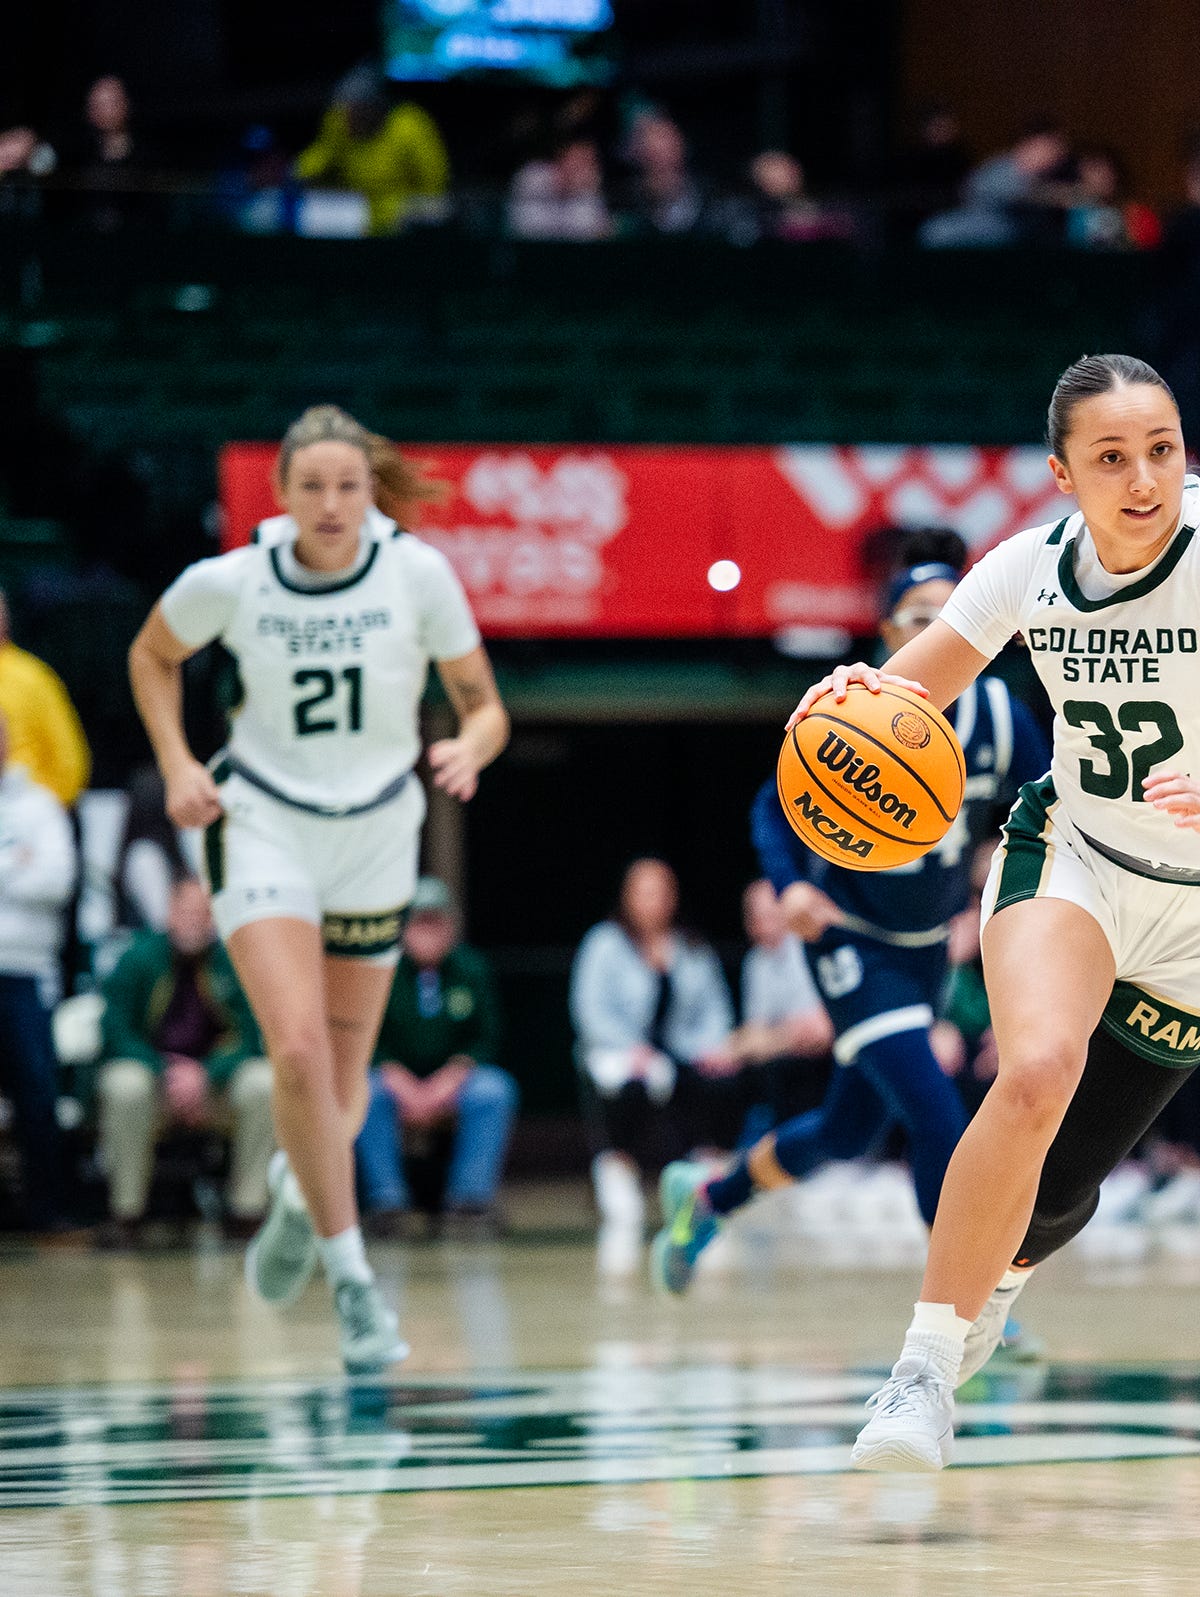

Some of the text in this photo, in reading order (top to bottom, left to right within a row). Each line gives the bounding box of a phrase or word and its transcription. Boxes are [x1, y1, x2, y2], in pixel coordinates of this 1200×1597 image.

[1029, 627, 1198, 655] COLORADO
[1063, 657, 1160, 683] STATE
[293, 667, 363, 736] 21
[816, 729, 917, 830] Wilson
[1063, 700, 1190, 802] 32
[793, 790, 875, 859] NCAA
